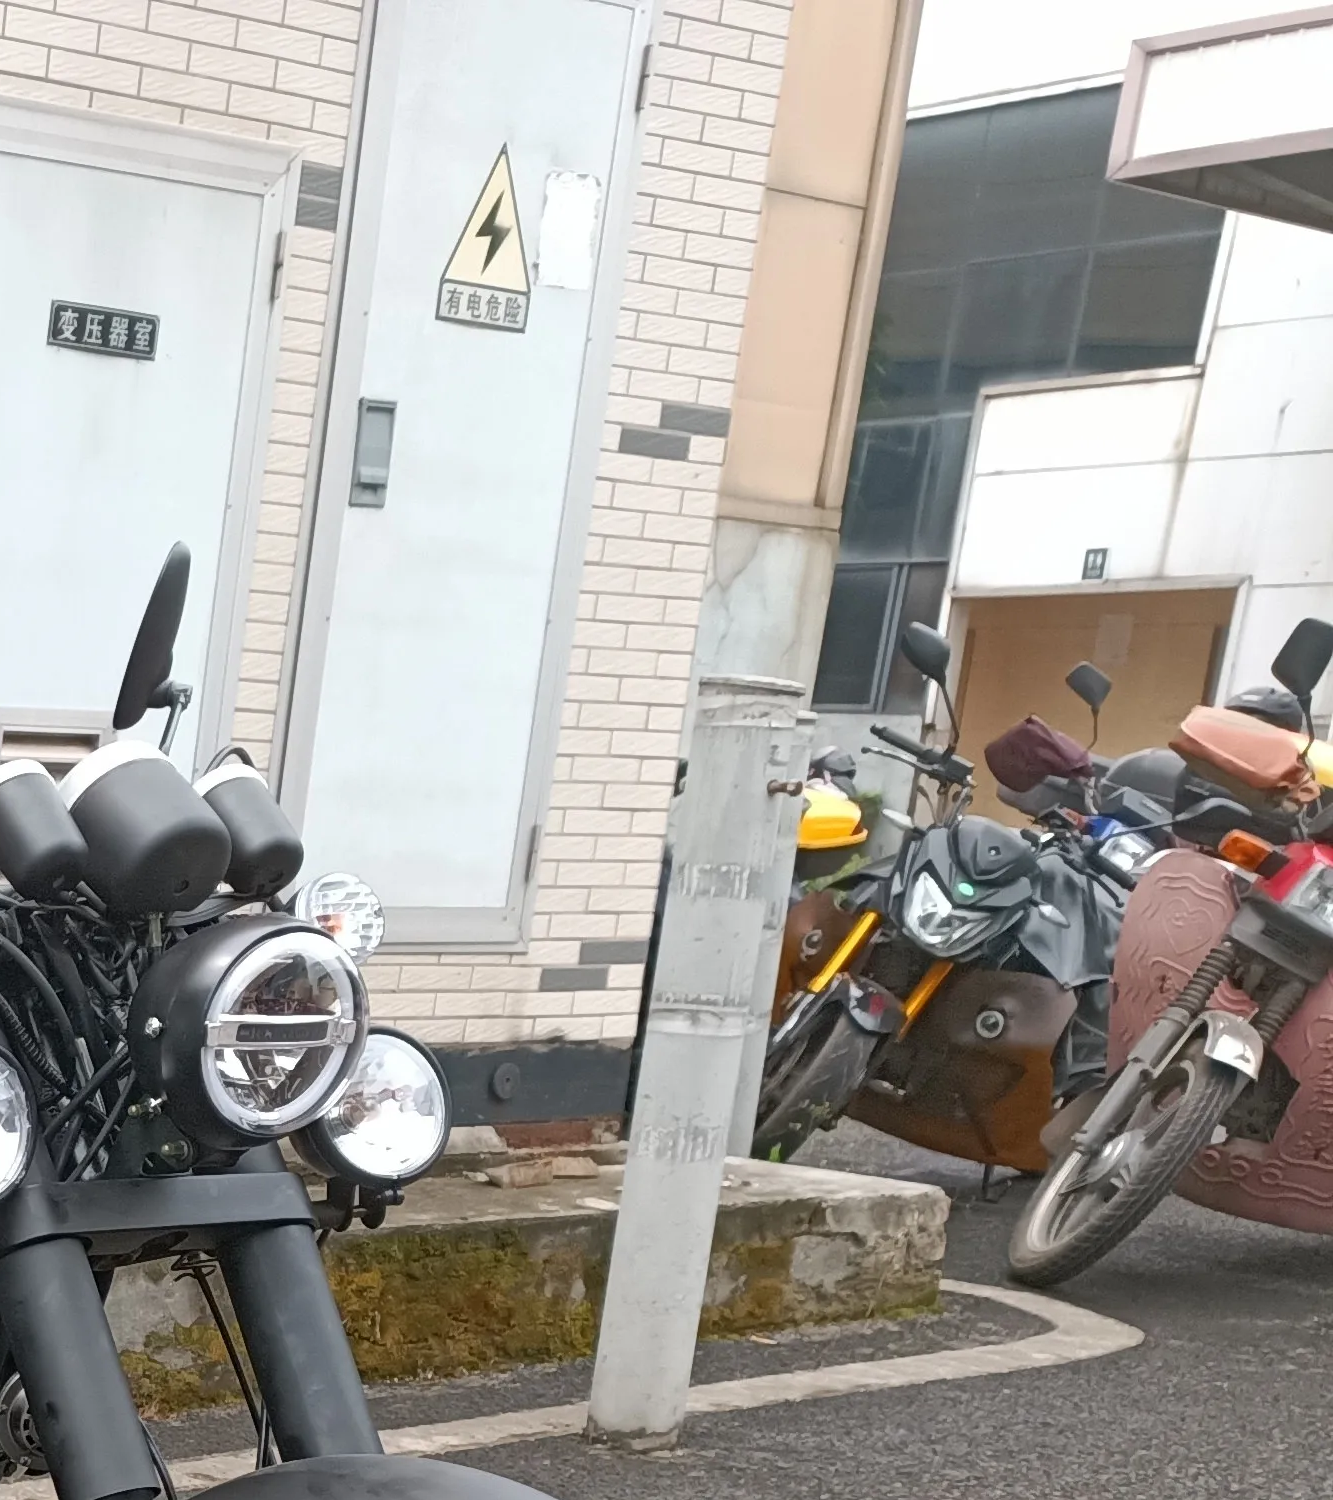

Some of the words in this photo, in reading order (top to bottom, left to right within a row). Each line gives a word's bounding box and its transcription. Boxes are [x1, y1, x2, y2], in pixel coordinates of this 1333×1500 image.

[444, 287, 522, 324] 有电危险
[56, 307, 153, 352] 变压器室
